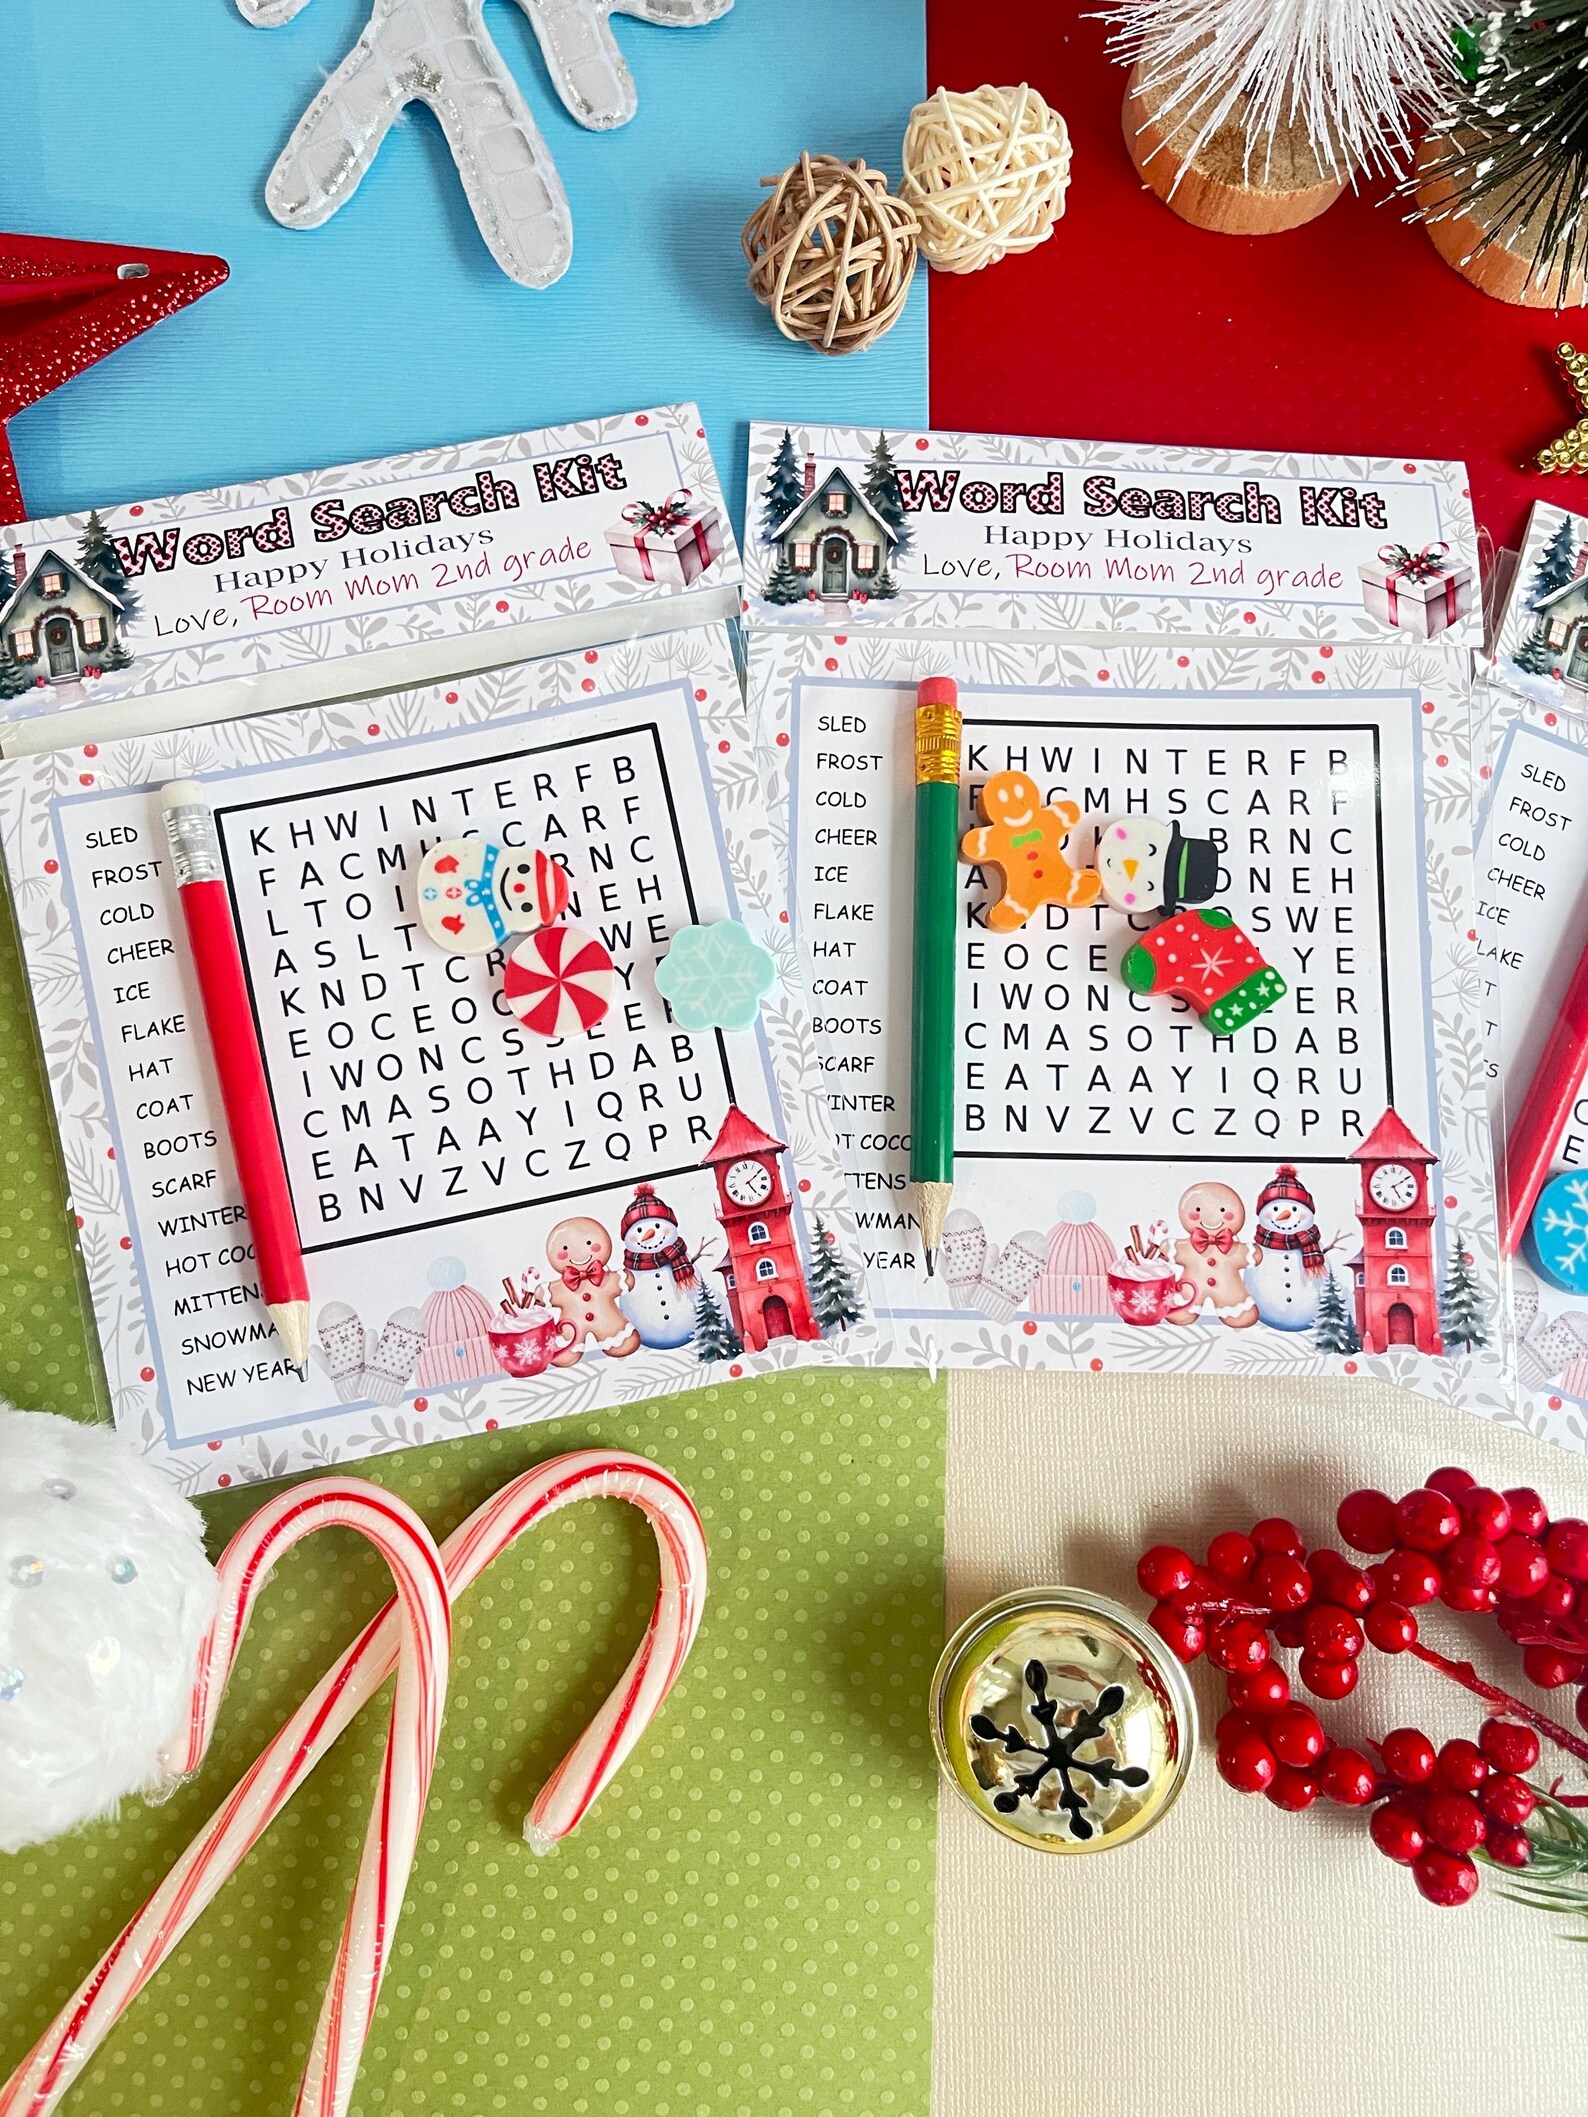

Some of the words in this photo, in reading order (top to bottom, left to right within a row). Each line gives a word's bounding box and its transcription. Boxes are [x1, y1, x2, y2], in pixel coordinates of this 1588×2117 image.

[894, 470, 1064, 515] Word
[1083, 476, 1281, 525] Search
[1300, 486, 1388, 529] Kit
[110, 507, 294, 578] Word
[311, 471, 519, 542] Search
[533, 453, 627, 502] Kit
[983, 525, 1093, 551] Happy
[1105, 528, 1252, 556] Holidays
[213, 558, 328, 593] Happy
[341, 529, 494, 569] Holidays
[155, 607, 237, 637] Love,
[240, 589, 332, 620] Room
[344, 575, 418, 600] Mom
[431, 551, 491, 588] 2nd
[504, 536, 591, 582] grade
[923, 554, 1000, 581] Love,
[1005, 554, 1091, 580] Room
[1106, 557, 1174, 583] Mom
[1188, 560, 1245, 585] 2nd
[1257, 563, 1343, 595] grade
[818, 716, 866, 733] SLED
[817, 753, 883, 770] FROST
[1521, 764, 1566, 792] SLED
[815, 791, 866, 808] COLD
[1509, 796, 1572, 831] FROST
[86, 827, 138, 848] SLED
[815, 829, 877, 845] CHEER
[1498, 833, 1545, 861] COLD
[92, 861, 162, 888] FROST
[814, 866, 848, 882] ICE
[1487, 867, 1546, 900] CHEER
[100, 903, 154, 925] COLD
[814, 903, 874, 921] FLAKE
[1476, 901, 1510, 925] ICE
[107, 939, 175, 964] CHEER
[813, 941, 856, 957] HAT
[1476, 937, 1523, 970] LAKE
[113, 982, 150, 1003] ICE
[813, 980, 868, 995] COAT
[121, 1015, 185, 1043] FLAKE
[812, 1017, 881, 1034] BOOTS
[129, 1058, 173, 1081] HAT
[136, 1094, 193, 1119] COAT
[827, 1095, 895, 1111] INTER
[143, 1130, 217, 1159] BOOTS
[152, 1170, 217, 1198] SCARF
[158, 1205, 247, 1236] WINTER
[165, 1253, 211, 1277] HOT
[863, 1252, 915, 1269] YEAR
[174, 1283, 263, 1316] MITTEN
[182, 1322, 279, 1355] SNOWMA
[187, 1369, 236, 1396] NEW
[242, 1358, 298, 1383] YEAR
